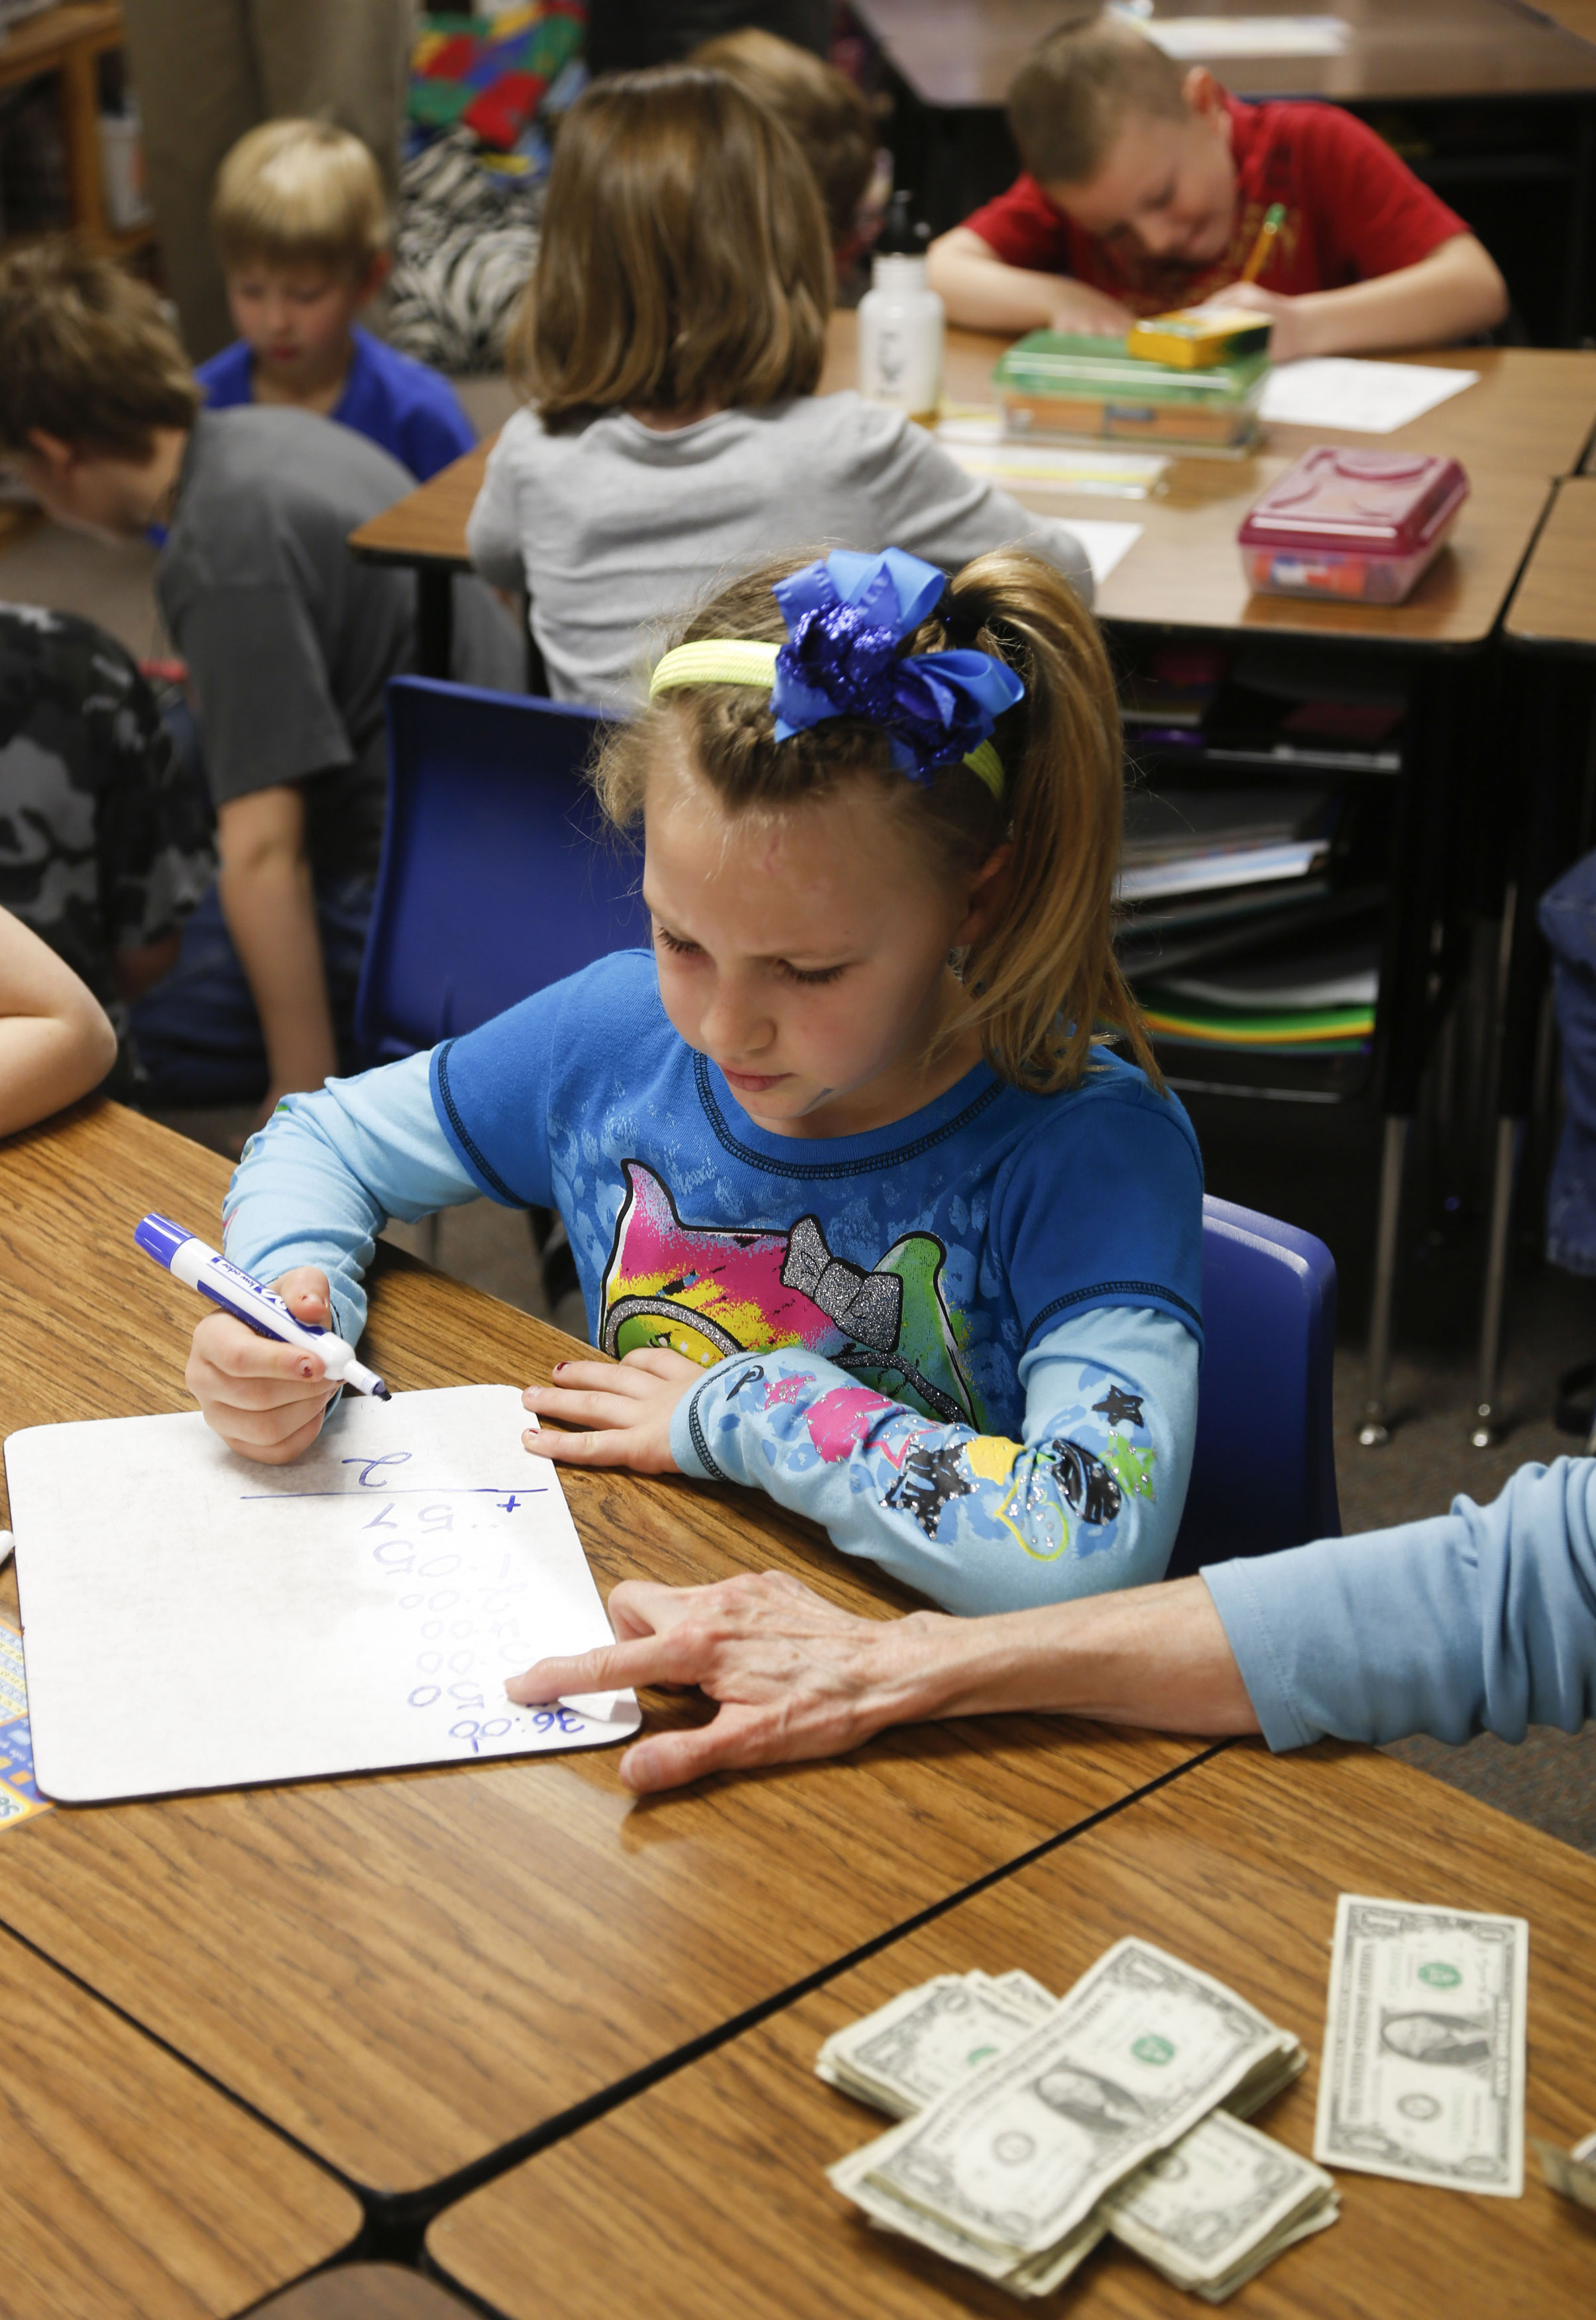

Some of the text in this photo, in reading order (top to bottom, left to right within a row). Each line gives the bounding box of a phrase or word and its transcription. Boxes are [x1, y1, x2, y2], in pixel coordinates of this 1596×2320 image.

[221, 1262, 256, 1288] low odor
[341, 1452, 412, 1487] 2
